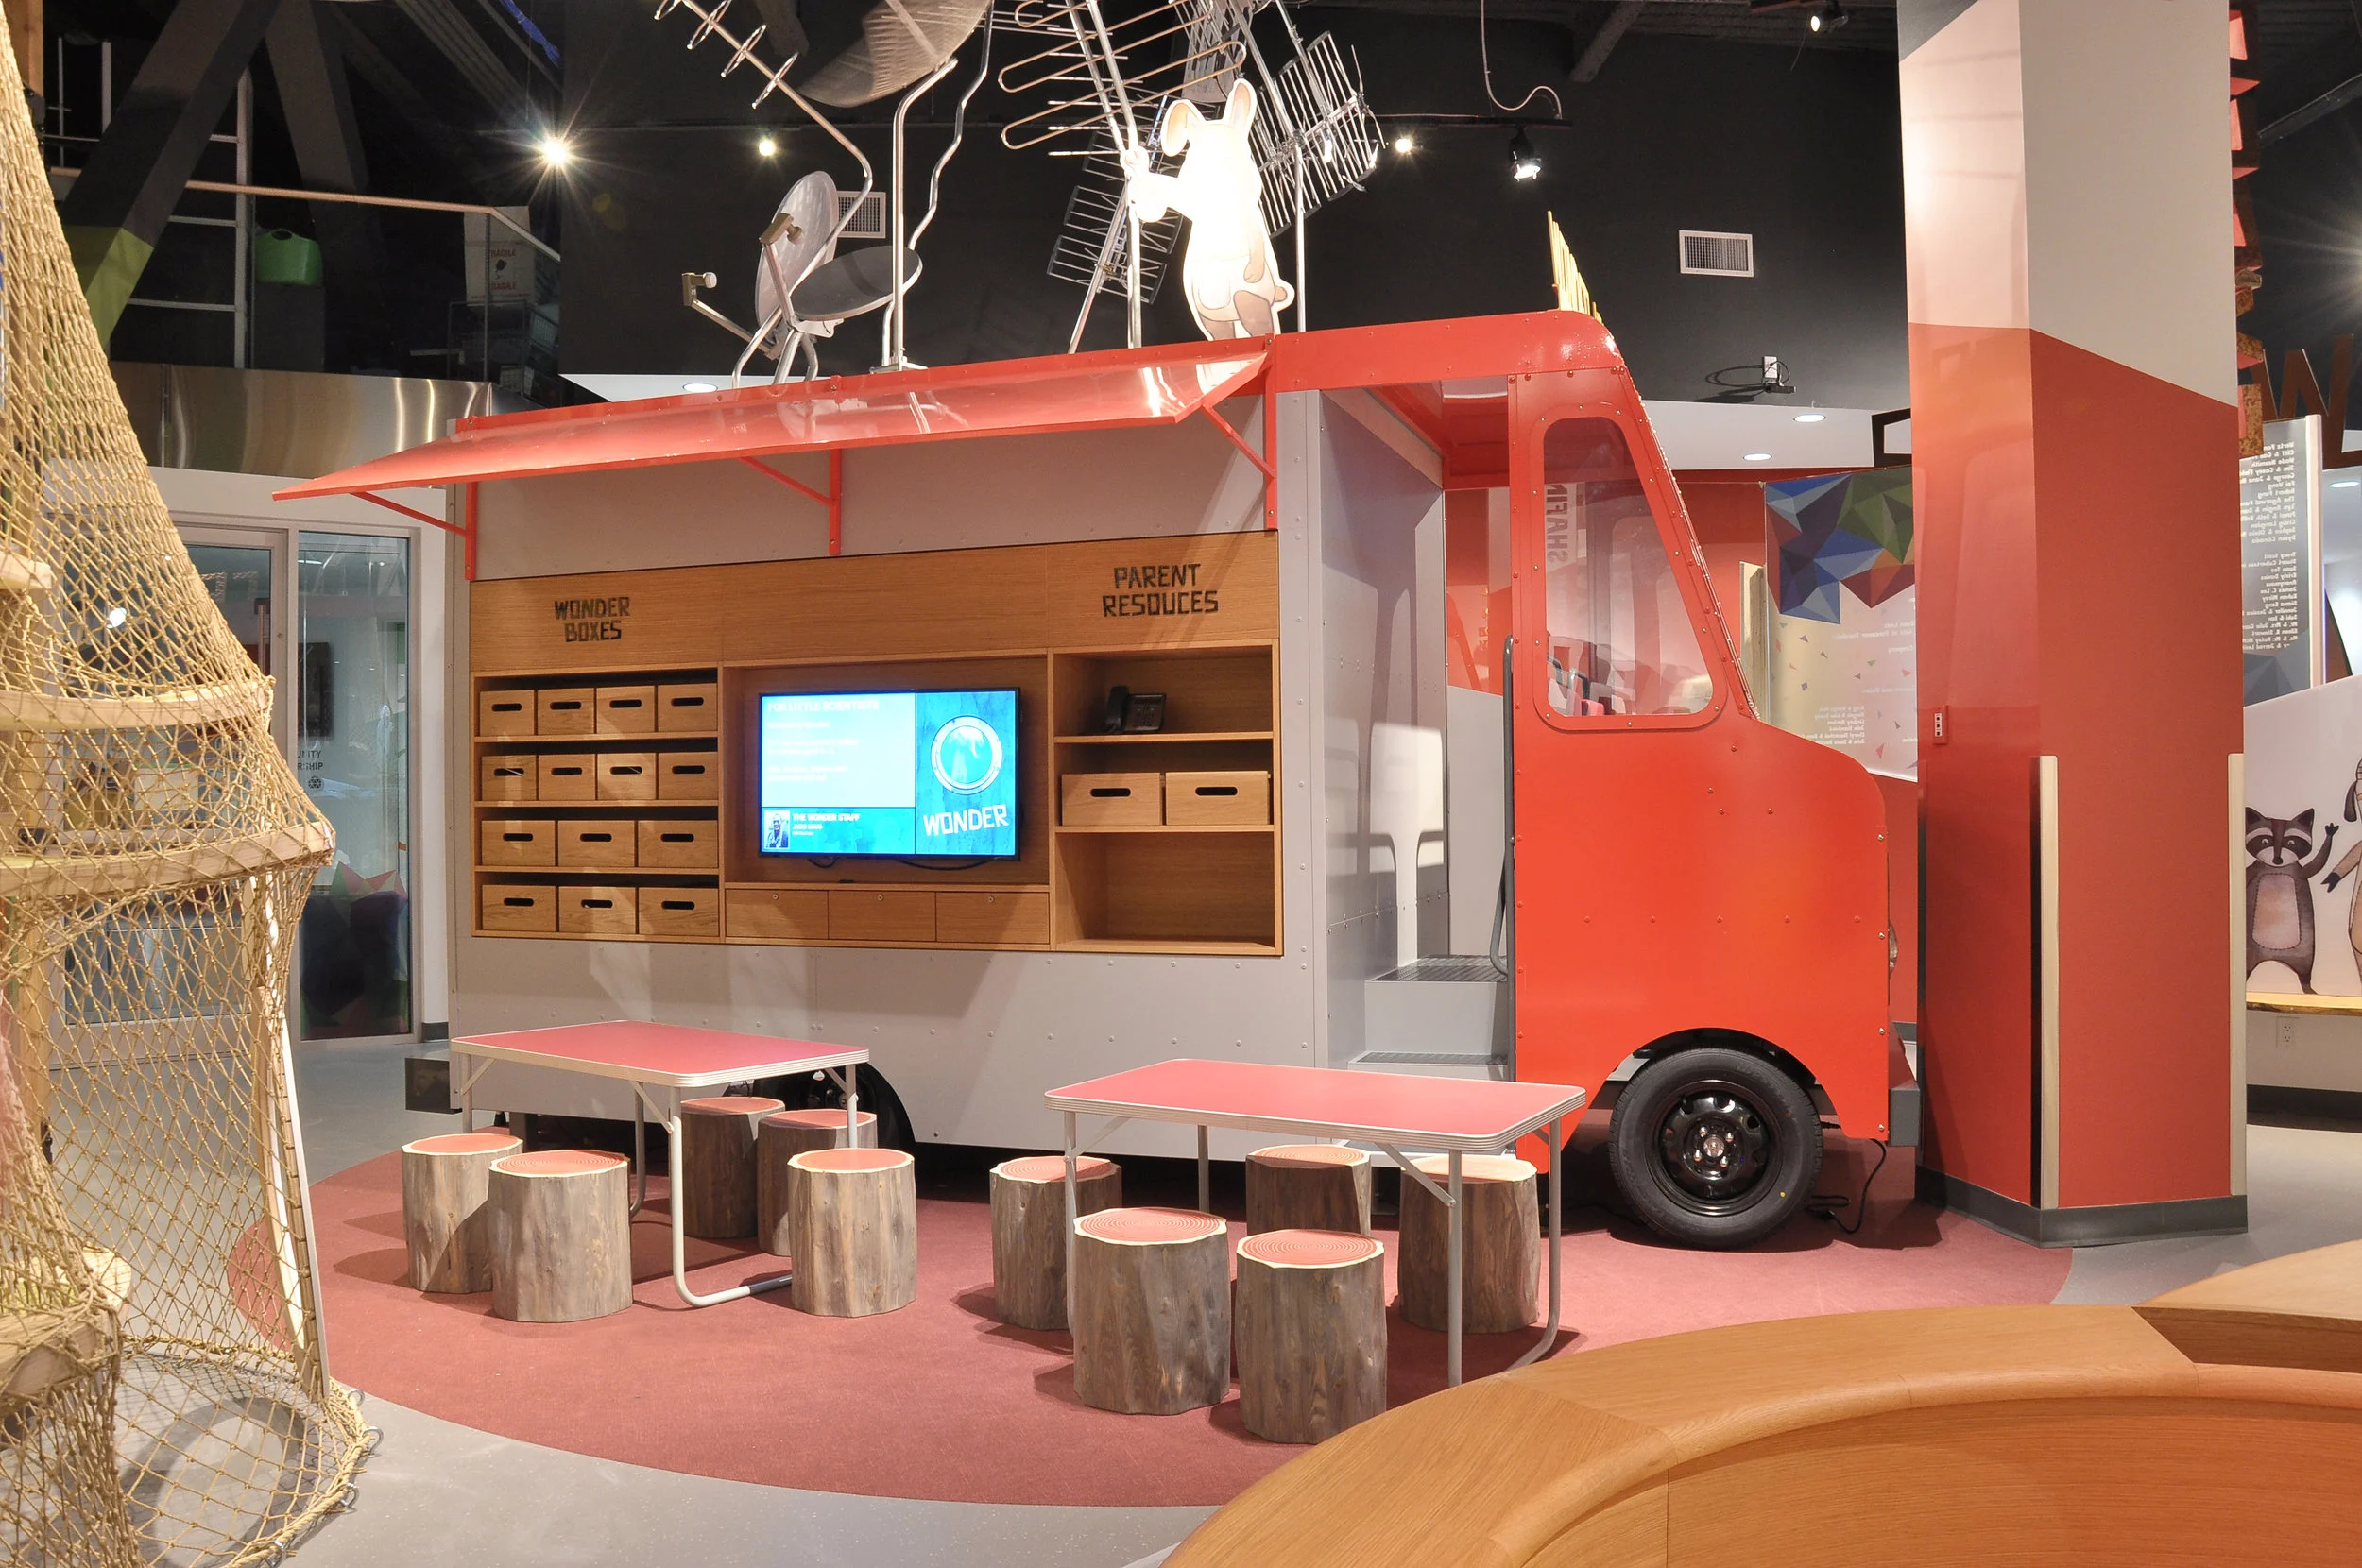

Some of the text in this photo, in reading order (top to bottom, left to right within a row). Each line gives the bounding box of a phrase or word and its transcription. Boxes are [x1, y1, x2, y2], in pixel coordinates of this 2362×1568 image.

[1114, 564, 1201, 588] PARENT
[555, 597, 630, 620] WONDER
[1103, 590, 1219, 617] RESOUCES
[565, 620, 622, 642] BOXES
[767, 699, 880, 712] FOR LITTLE SCIENTISTS
[808, 813, 837, 822] WONDER
[838, 813, 860, 822] STAFF
[924, 804, 1008, 836] WONDER
